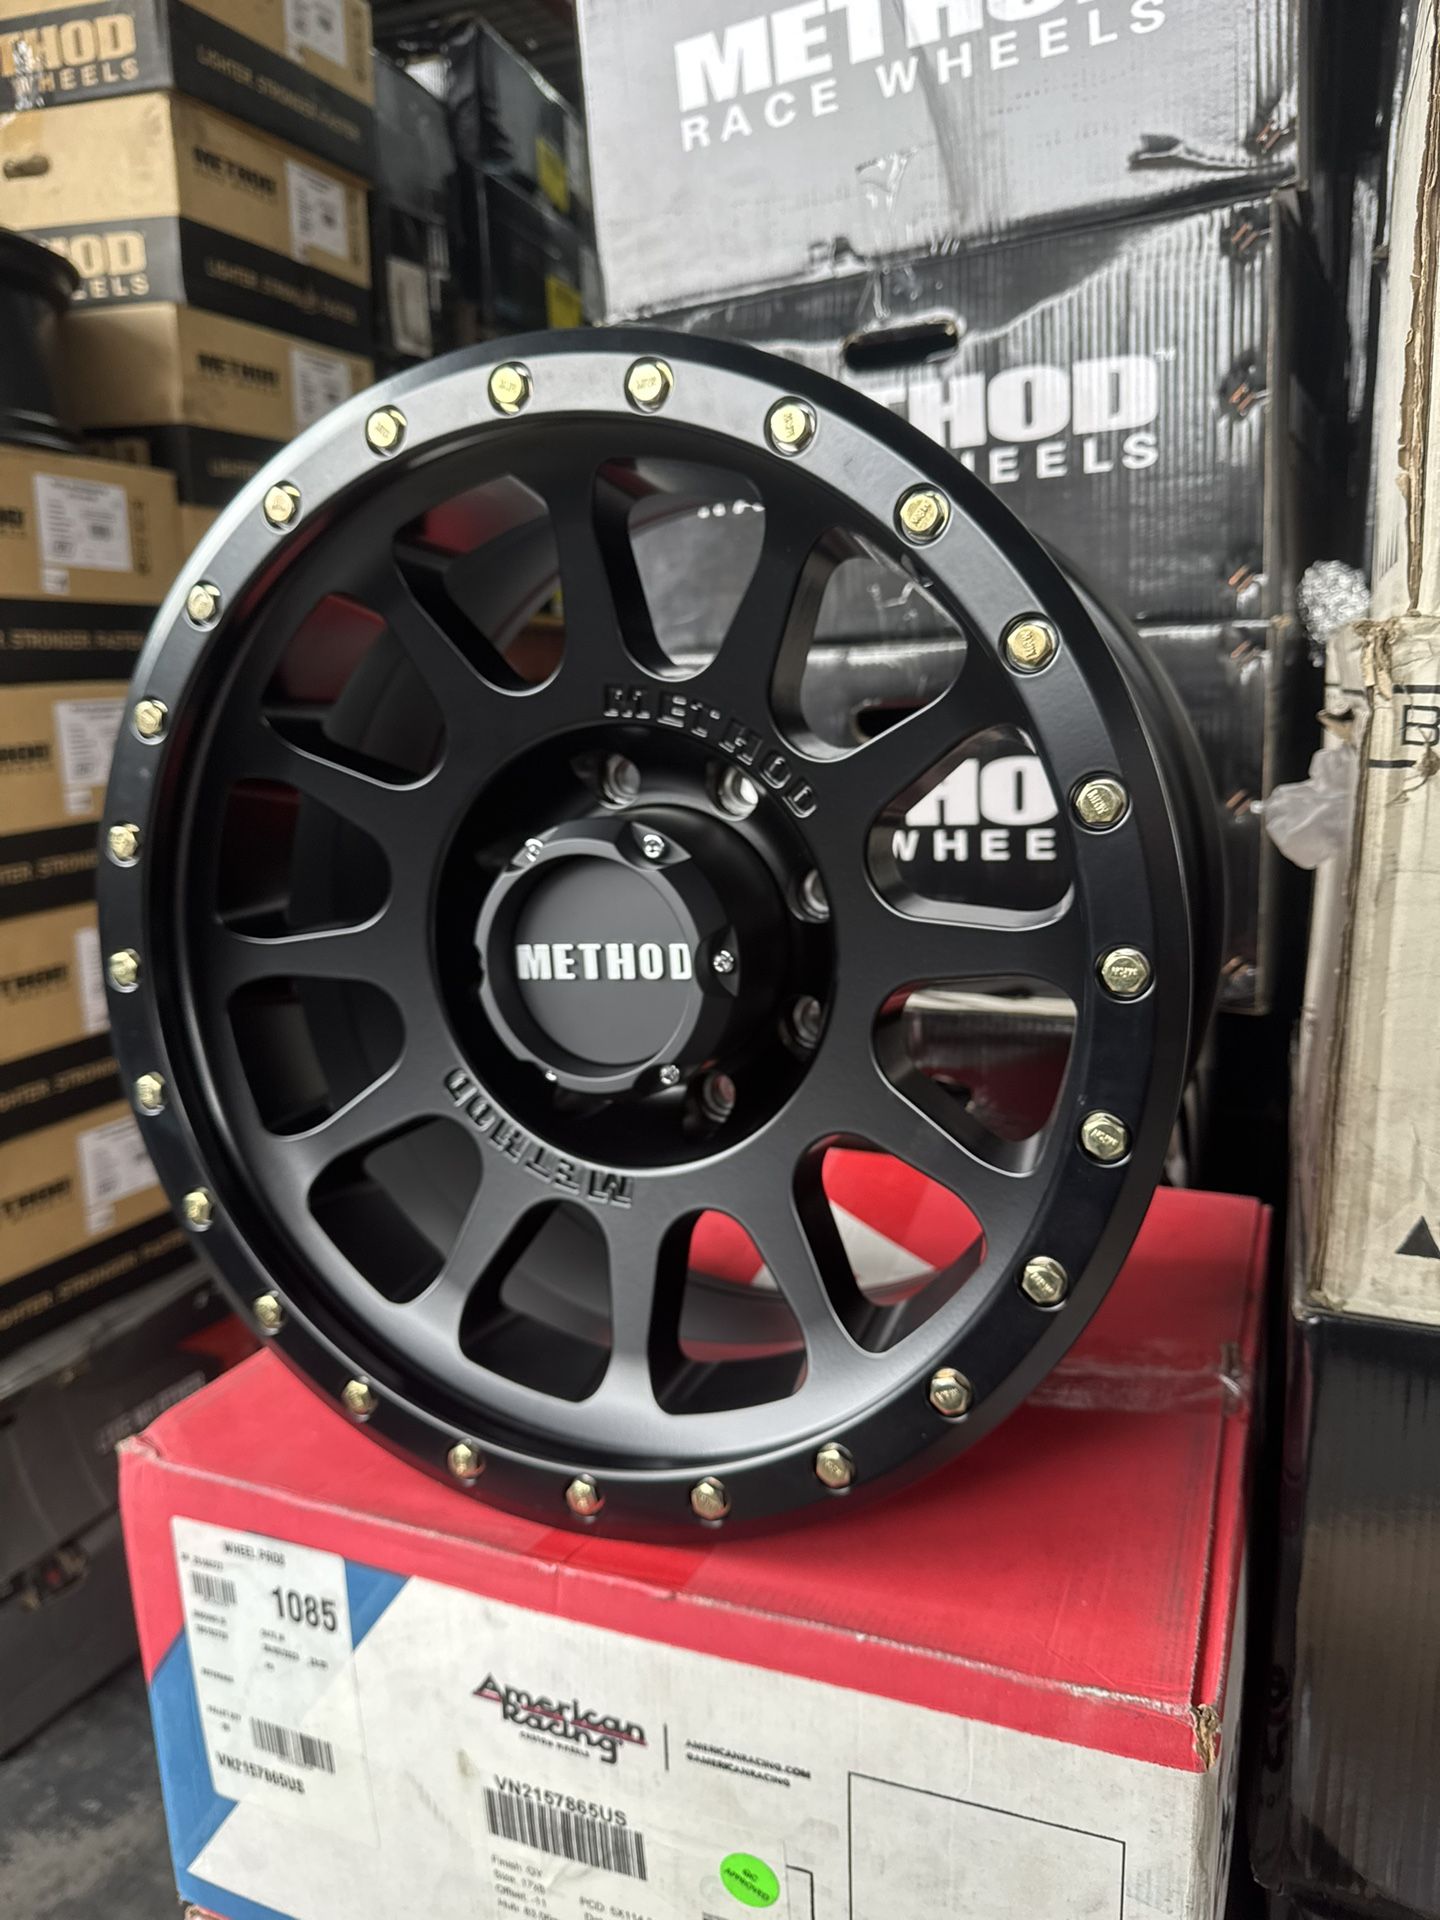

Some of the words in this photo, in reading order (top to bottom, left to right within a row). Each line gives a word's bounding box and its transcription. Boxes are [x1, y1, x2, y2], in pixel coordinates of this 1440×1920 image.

[674, 0, 1098, 112] METH
[681, 79, 839, 152] RACE
[875, 0, 1167, 98] WHEELS
[889, 353, 1159, 450] HOD
[515, 943, 692, 981] METHOD
[272, 1585, 338, 1632] 1085
[472, 1671, 648, 1747] American
[501, 1700, 619, 1765] Racing
[685, 1738, 812, 1780] AMERICANRACING.COM
[494, 1773, 628, 1827] VN2157865US
